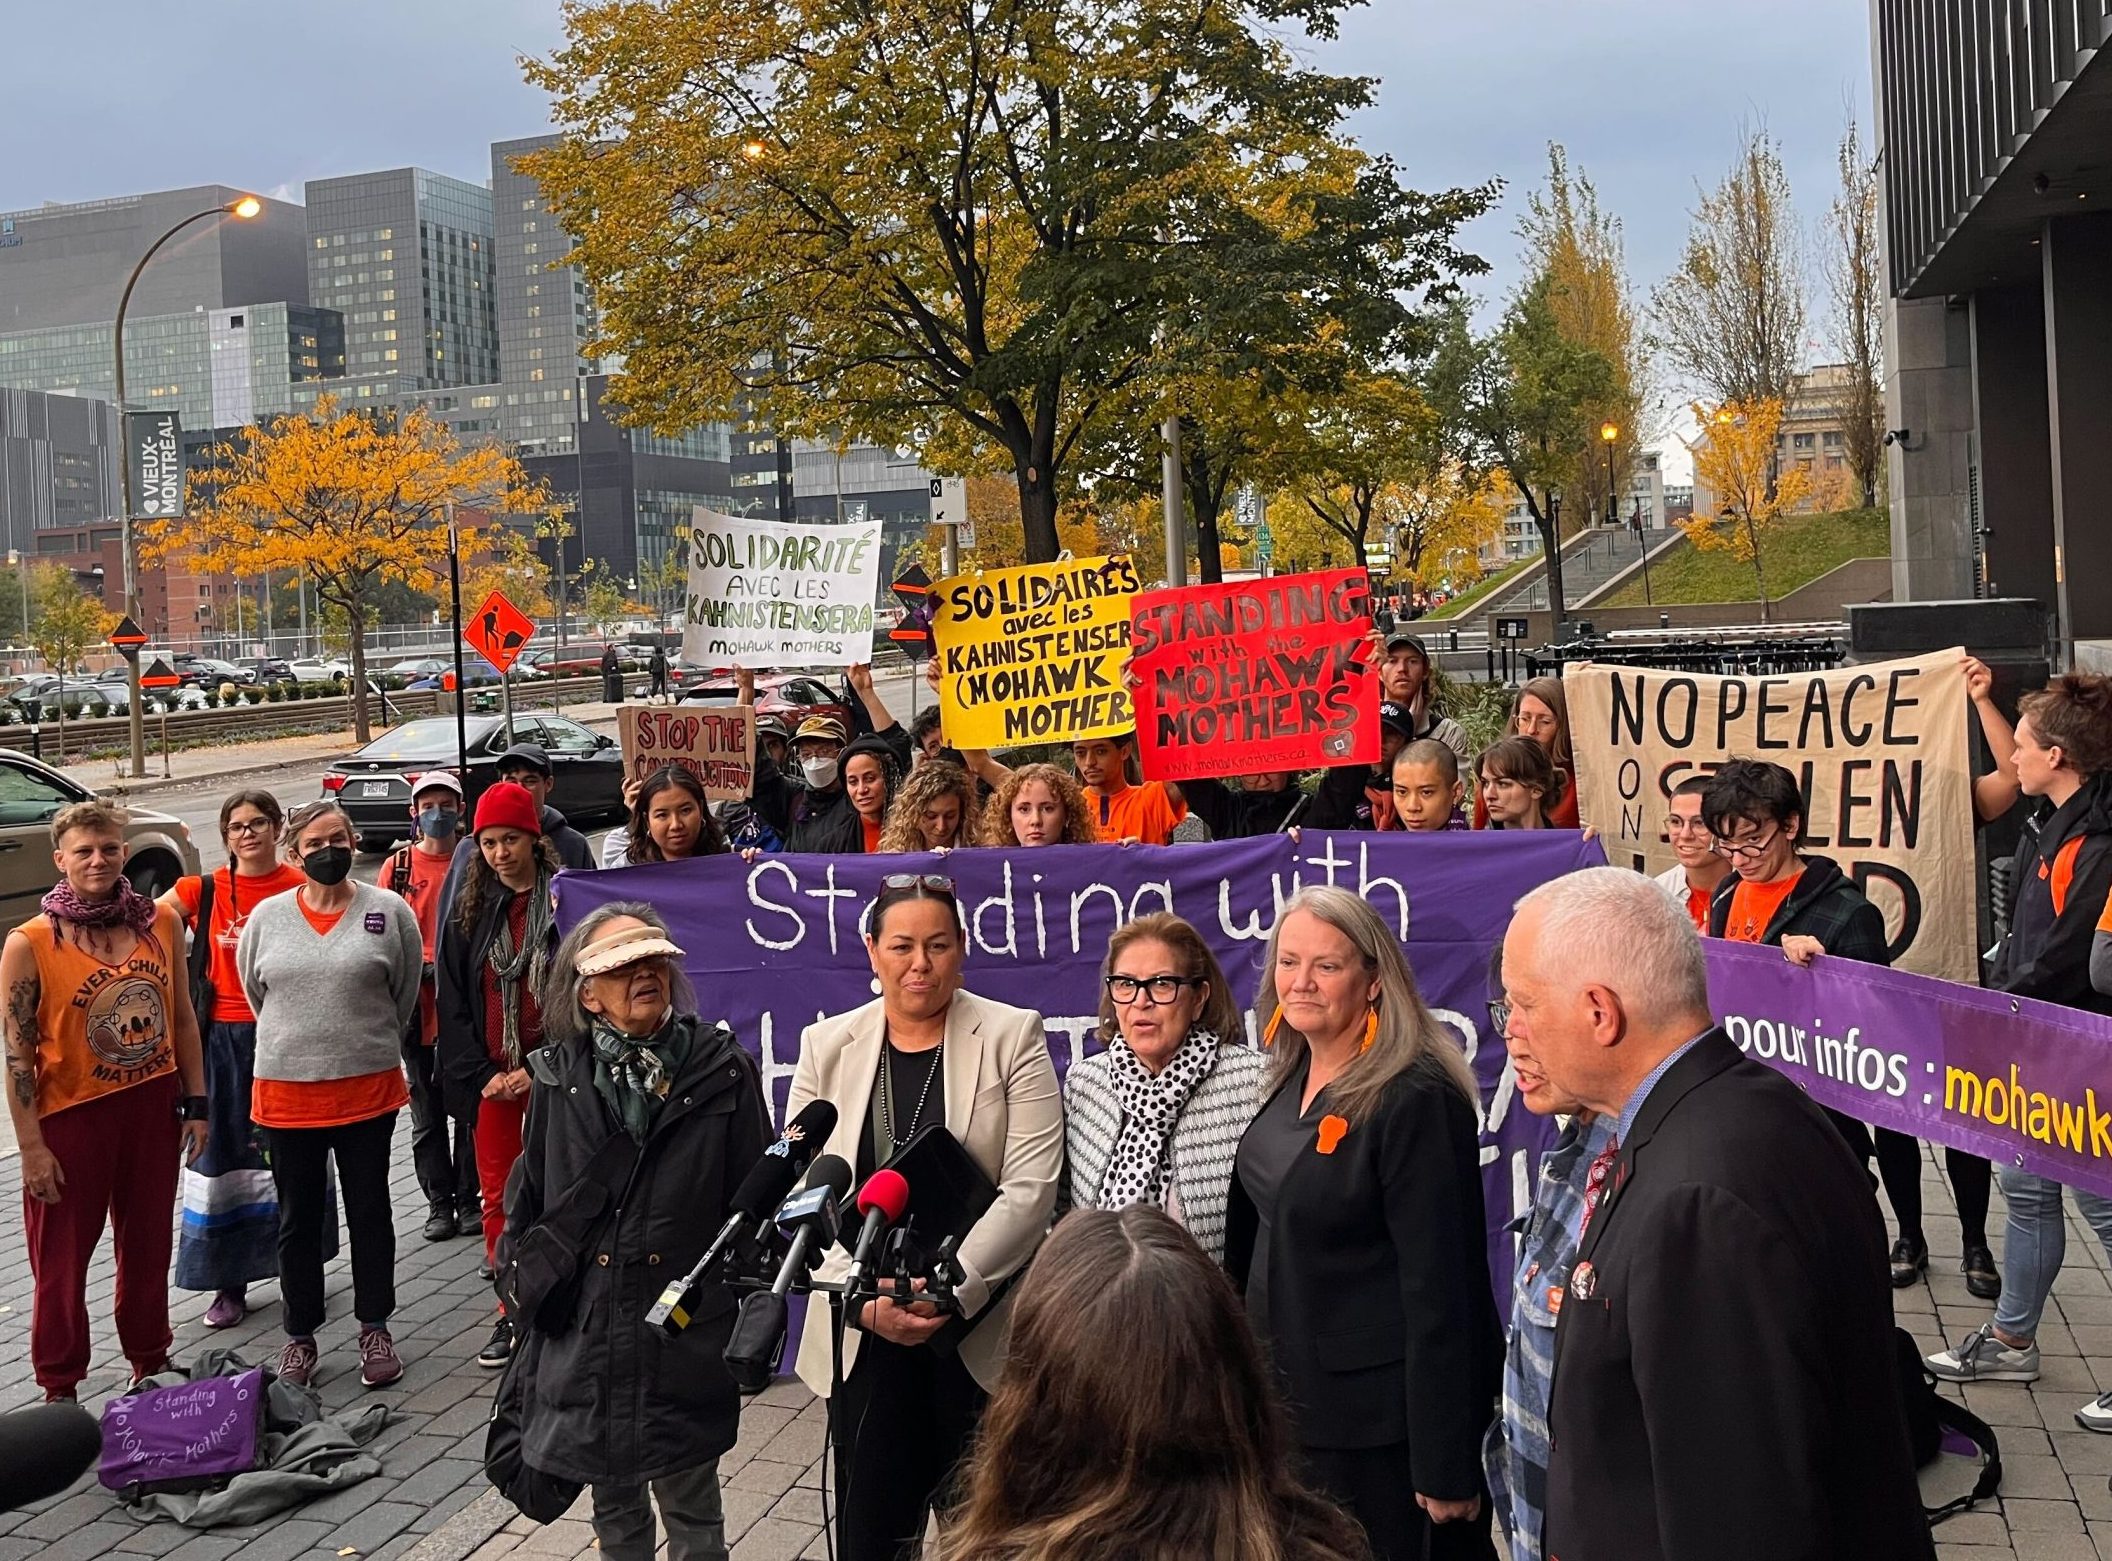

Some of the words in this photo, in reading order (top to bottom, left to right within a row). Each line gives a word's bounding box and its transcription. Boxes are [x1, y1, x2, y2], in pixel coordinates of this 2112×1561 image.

[142, 436, 159, 497] VIEUX-
[158, 416, 178, 514] MONTRÉAL
[692, 528, 876, 574] SOLIDARITÉ
[687, 593, 873, 634] KAHNISTENSERA
[726, 575, 780, 597] AVEC
[794, 579, 830, 599] LES
[950, 560, 1140, 622] SOLIDAIRES
[1002, 611, 1056, 636] avec
[1064, 604, 1093, 625] les
[1133, 577, 1370, 657] STANDING
[1155, 637, 1368, 708] MOHAWK
[1188, 638, 1248, 664] with
[1266, 633, 1307, 653] the
[956, 655, 1112, 710] (MOHAWK
[1611, 671, 1699, 749] NO
[1717, 668, 1920, 749] PEACE
[637, 711, 700, 752] STOP
[702, 715, 746, 753] THE
[1157, 685, 1358, 748] MOTHERS
[72, 966, 122, 1009] EVERY
[127, 959, 169, 987] CHILD
[1724, 1014, 1808, 1068] pour
[1814, 1017, 1908, 1098] infos
[1944, 1063, 2112, 1158] mohawk
[153, 1388, 216, 1412] Standing
[170, 1402, 202, 1419] with
[185, 1409, 239, 1464] Mothers
